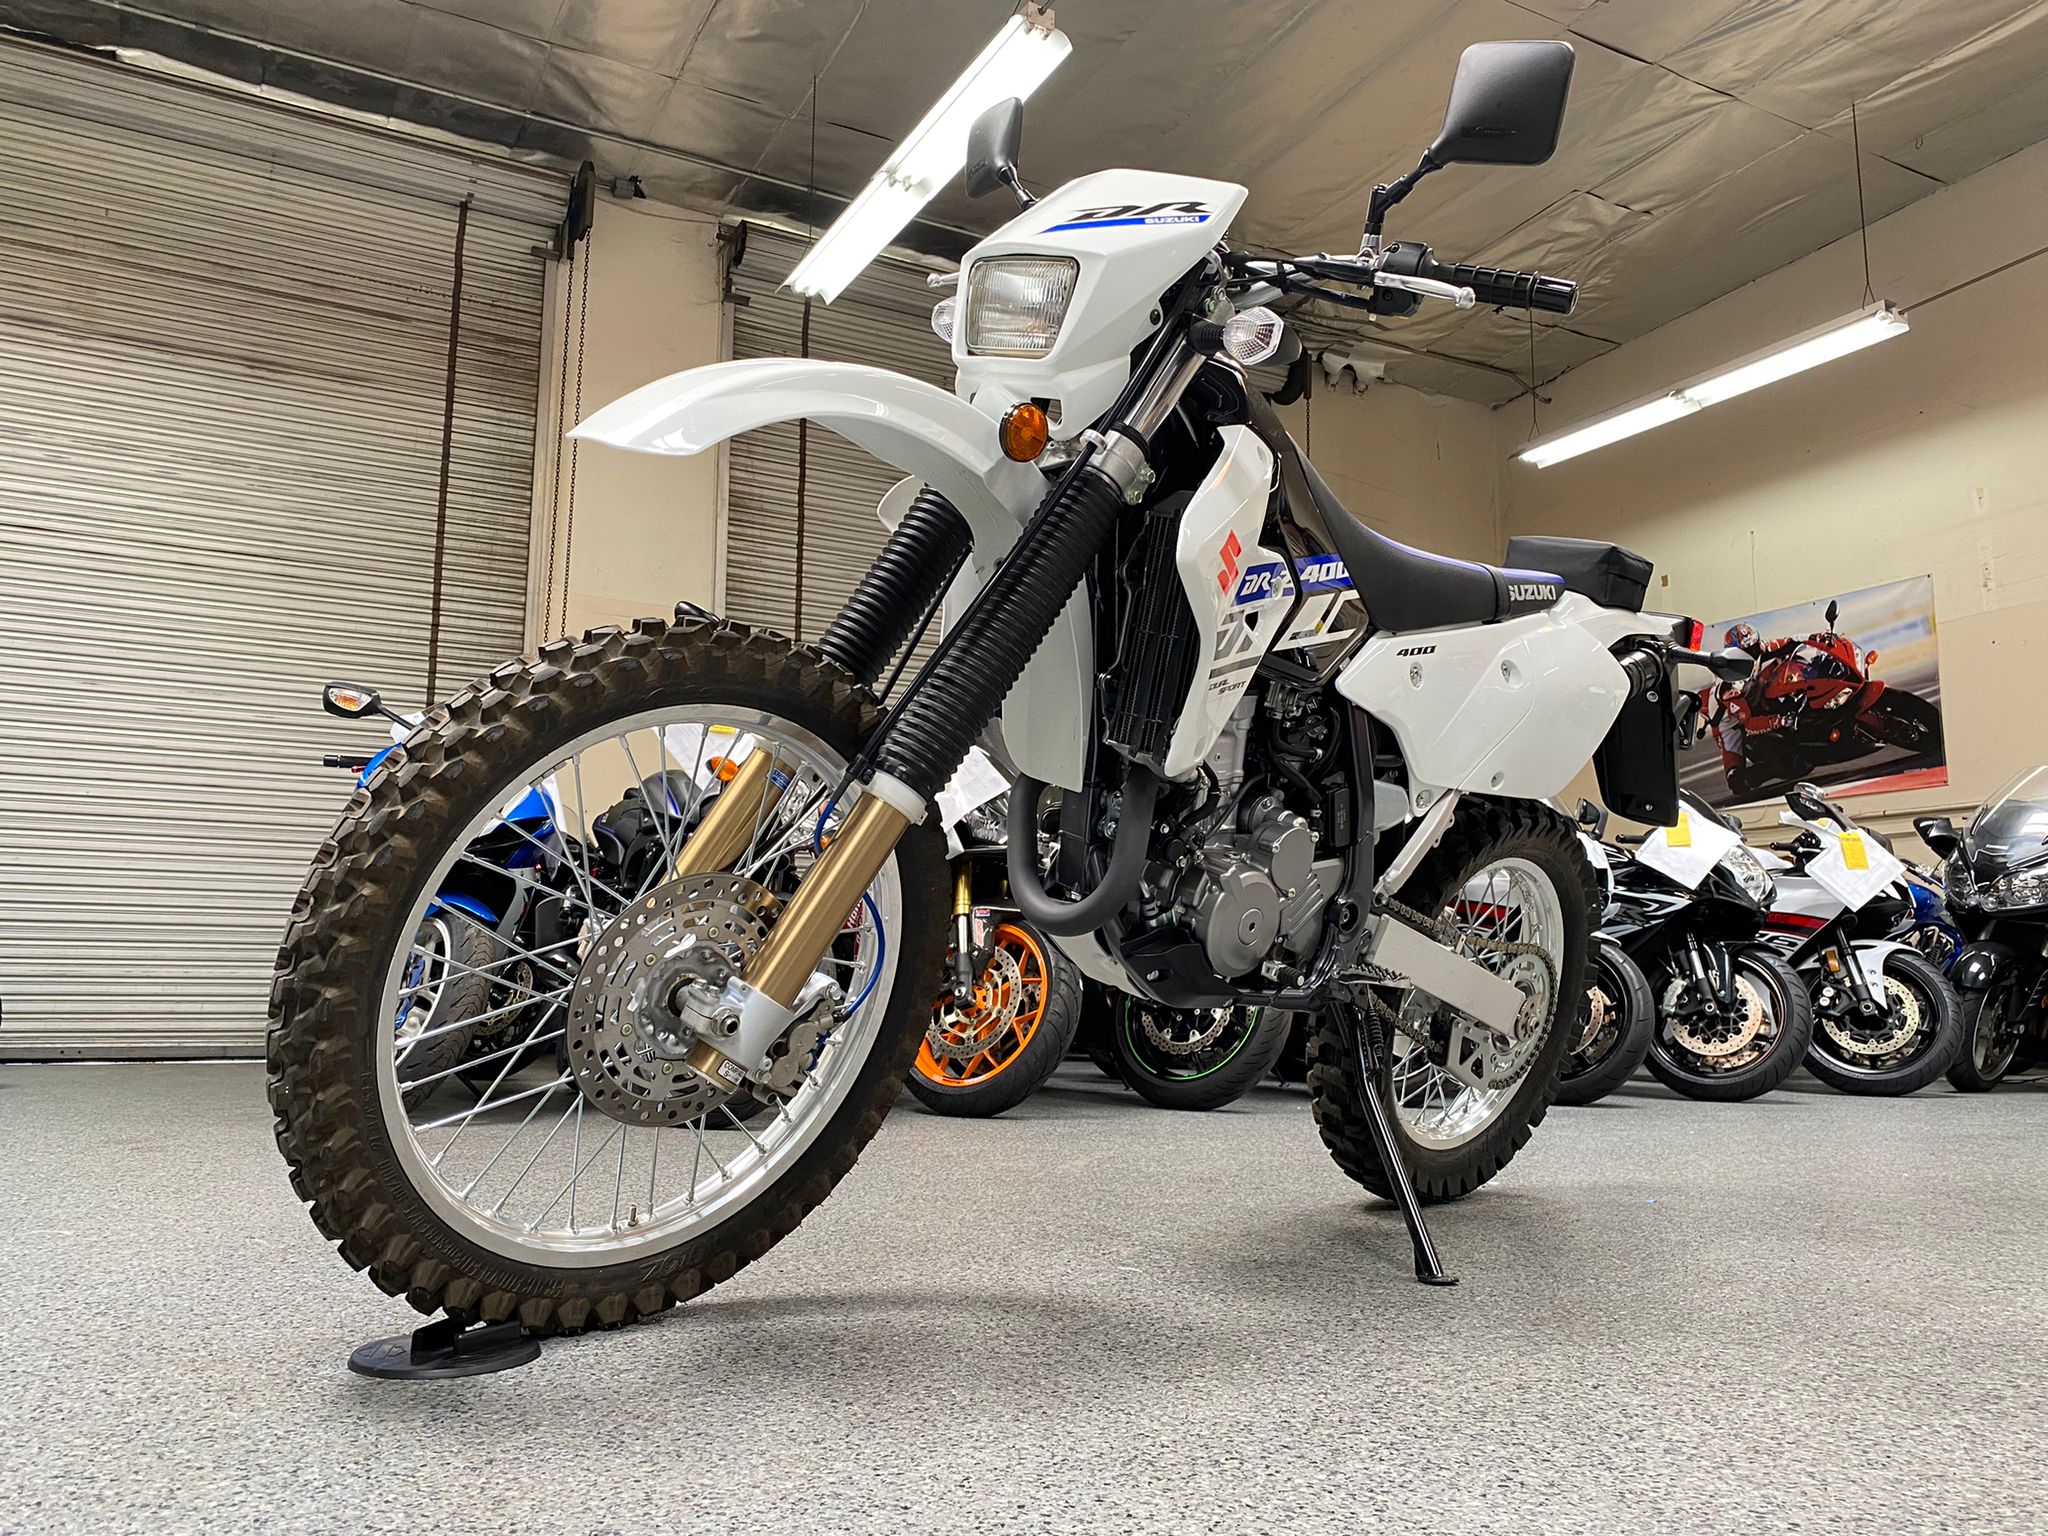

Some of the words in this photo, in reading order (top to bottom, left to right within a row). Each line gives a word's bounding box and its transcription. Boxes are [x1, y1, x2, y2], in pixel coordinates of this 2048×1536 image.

[1144, 216, 1200, 224] SUZUKI
[1508, 584, 1557, 601] SUZUKI
[1396, 645, 1437, 657] 400
[1208, 679, 1229, 691] DUAL
[1218, 681, 1247, 695] SPORT
